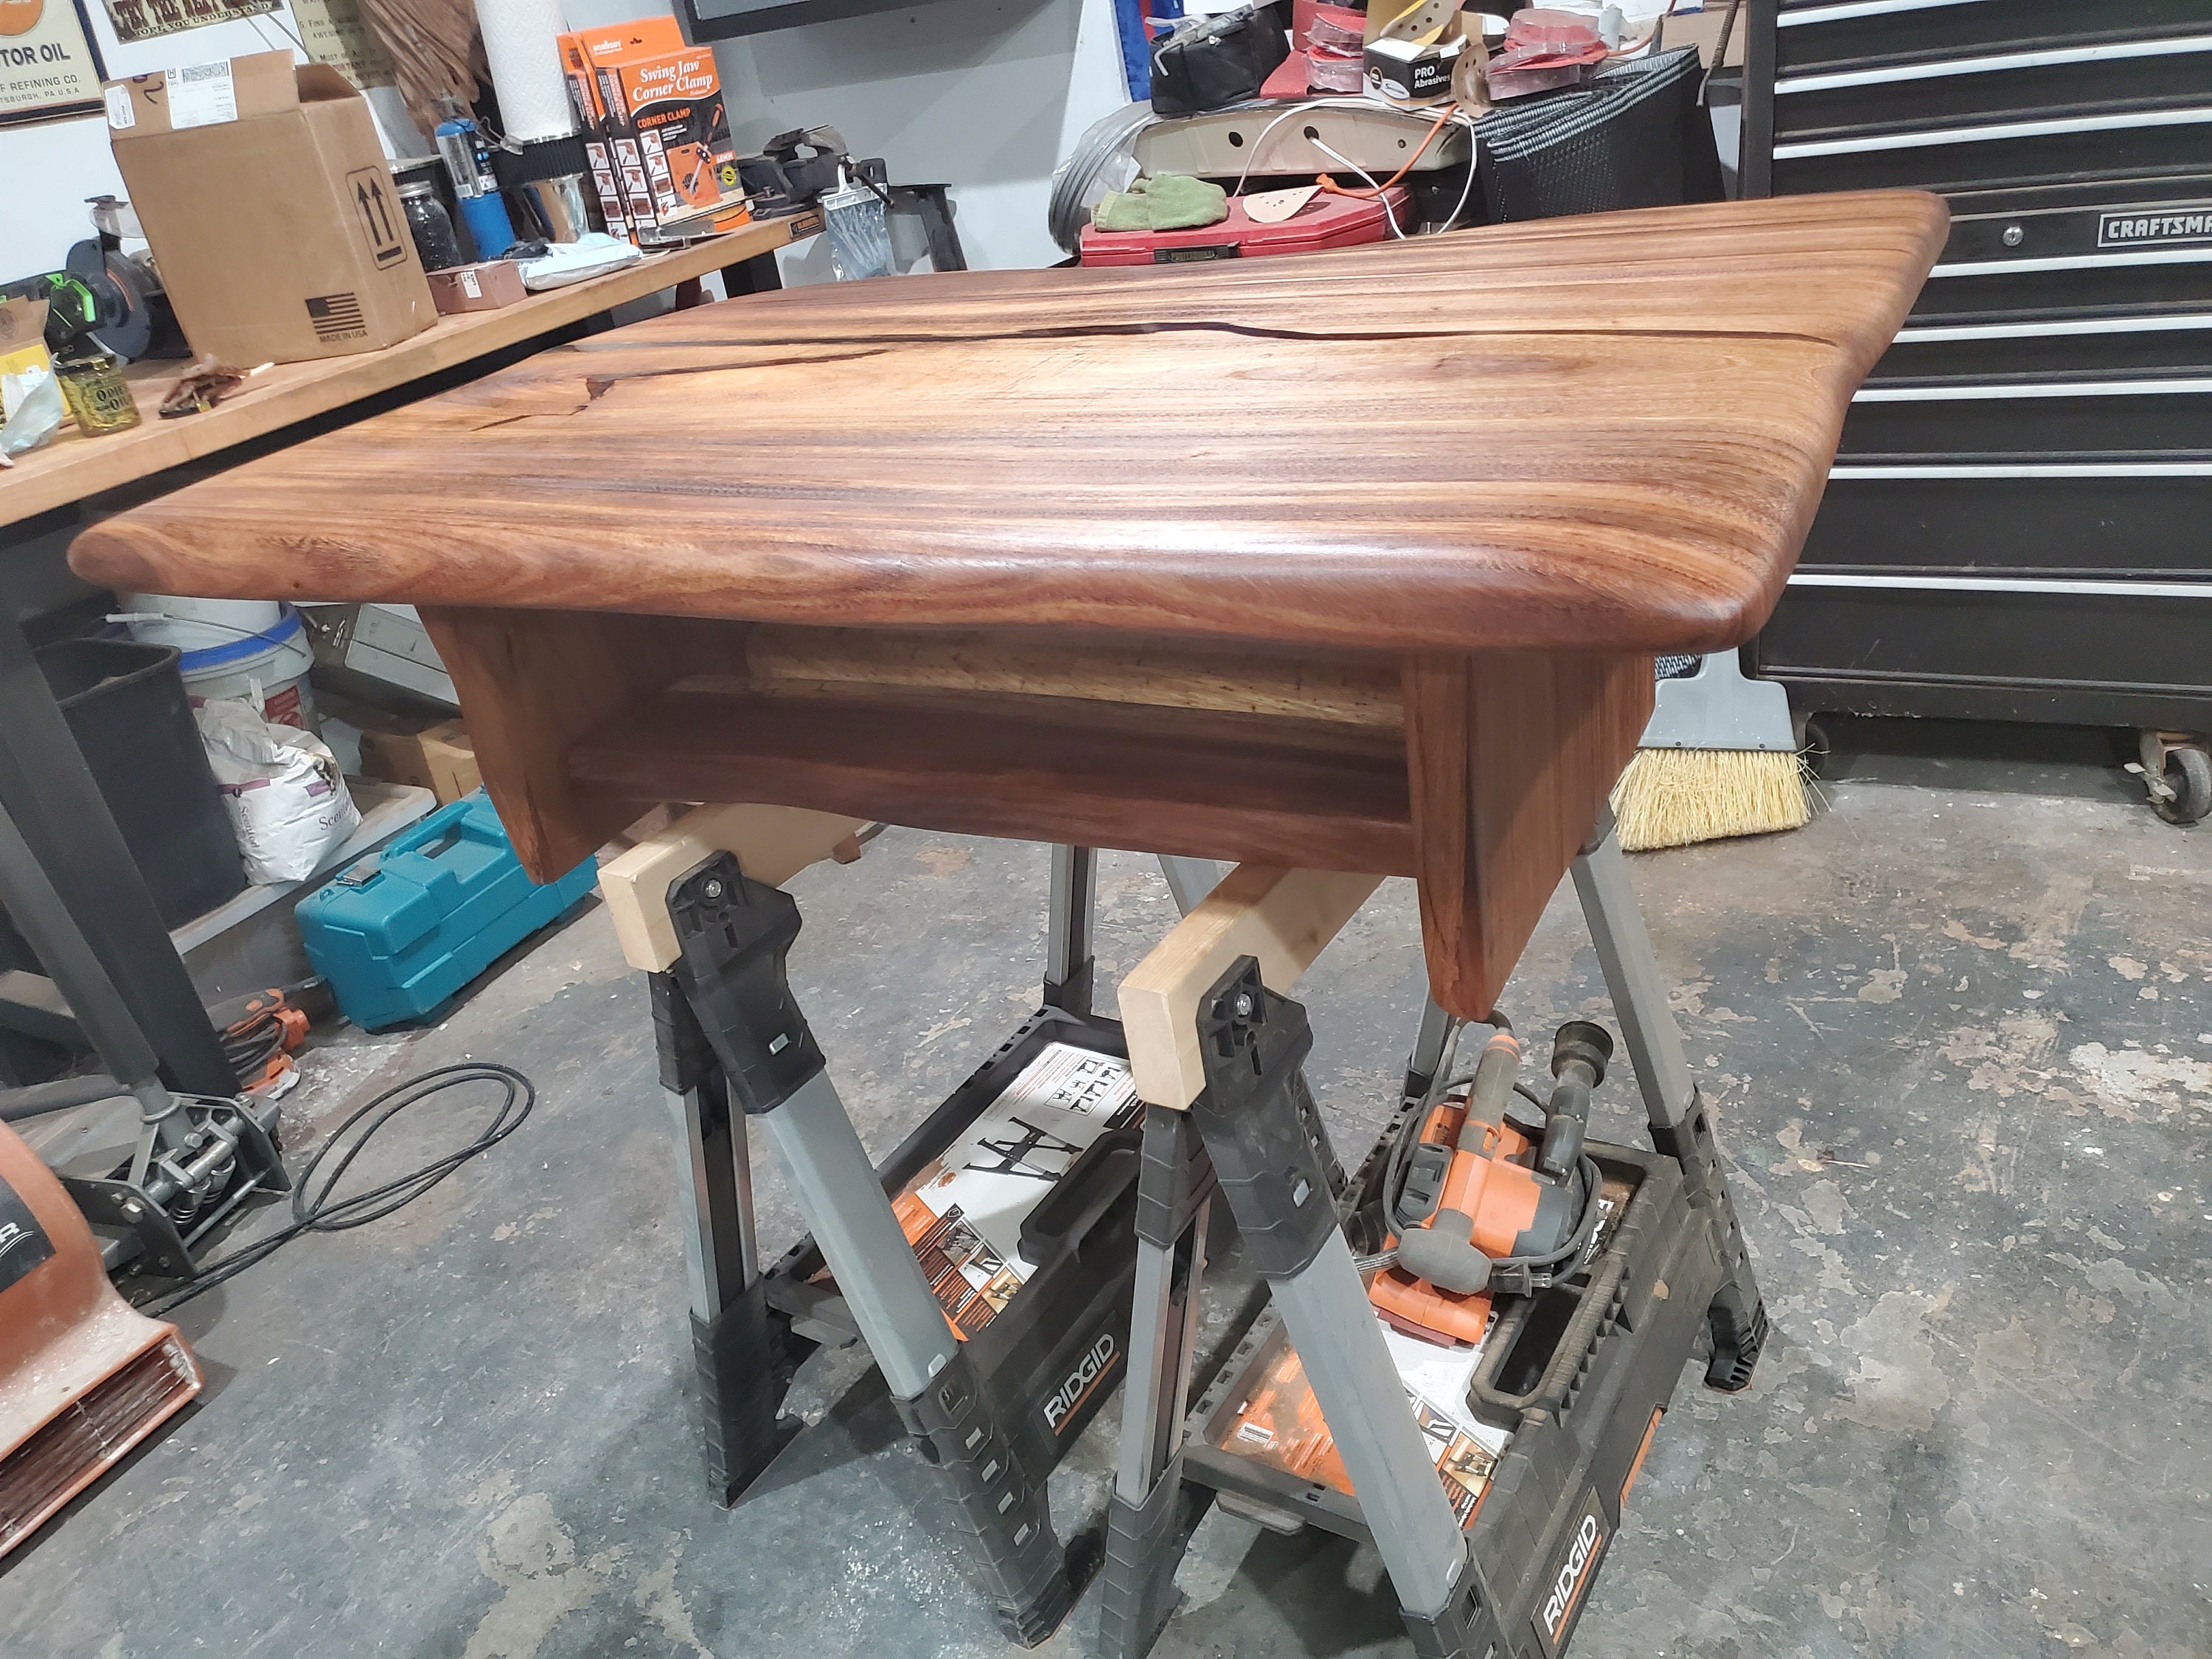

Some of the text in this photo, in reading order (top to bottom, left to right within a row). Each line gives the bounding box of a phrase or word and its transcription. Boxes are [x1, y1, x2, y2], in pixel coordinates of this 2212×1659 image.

[167, 19, 190, 29] YOU
[40, 43, 72, 63] OIL
[640, 60, 700, 83] Swing Jaw
[1414, 66, 1435, 80] PRO
[1414, 74, 1450, 88] Abrasives
[10, 77, 60, 91] REFINING
[63, 74, 81, 84] CO.
[633, 83, 674, 101] Corner
[675, 74, 714, 92] Clamp
[636, 107, 691, 129] CORNER CLAMP
[319, 333, 341, 343] MADE
[351, 330, 368, 339] USA
[240, 806, 261, 849] Scented
[1043, 1333, 1115, 1429] RIDGID
[1543, 1514, 1596, 1636] RIDGID
